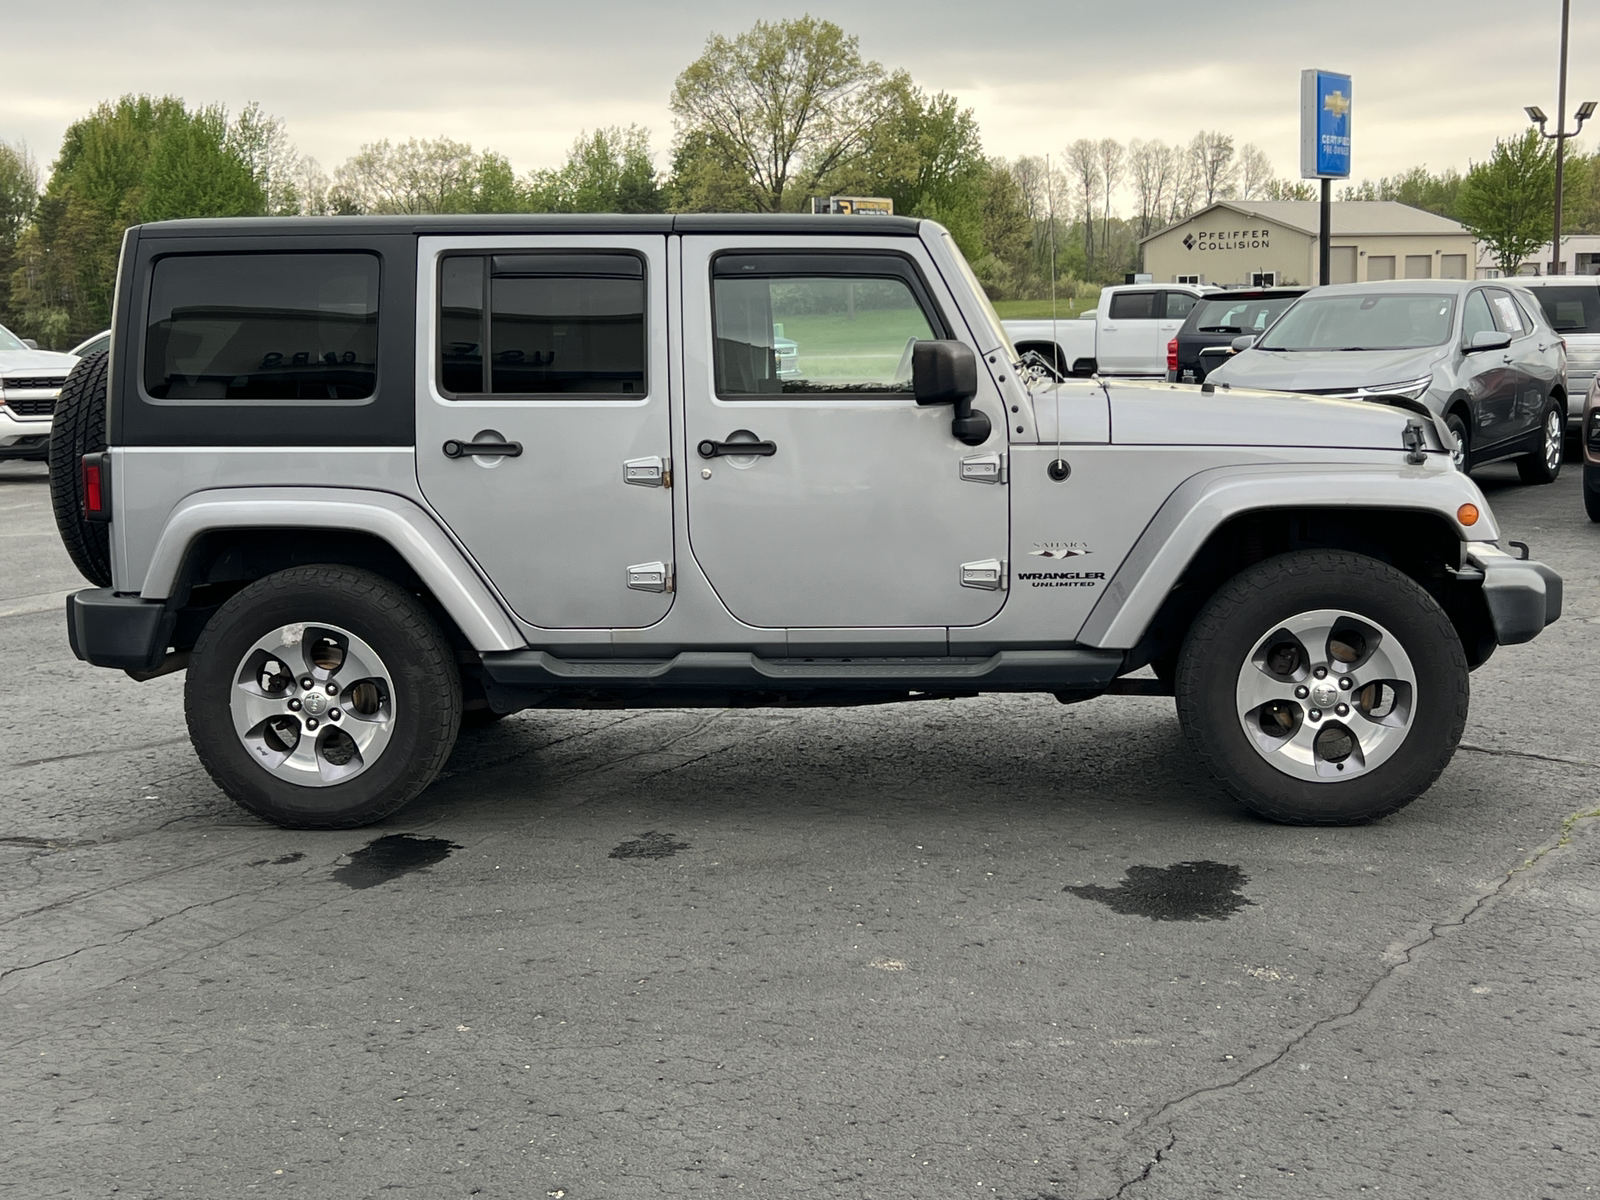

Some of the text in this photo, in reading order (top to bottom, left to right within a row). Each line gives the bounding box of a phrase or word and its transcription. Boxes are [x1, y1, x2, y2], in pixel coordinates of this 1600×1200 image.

[1199, 230, 1269, 240] PFEIFFER
[1199, 240, 1269, 250] COLLISION
[1018, 572, 1105, 580] WRANGLER
